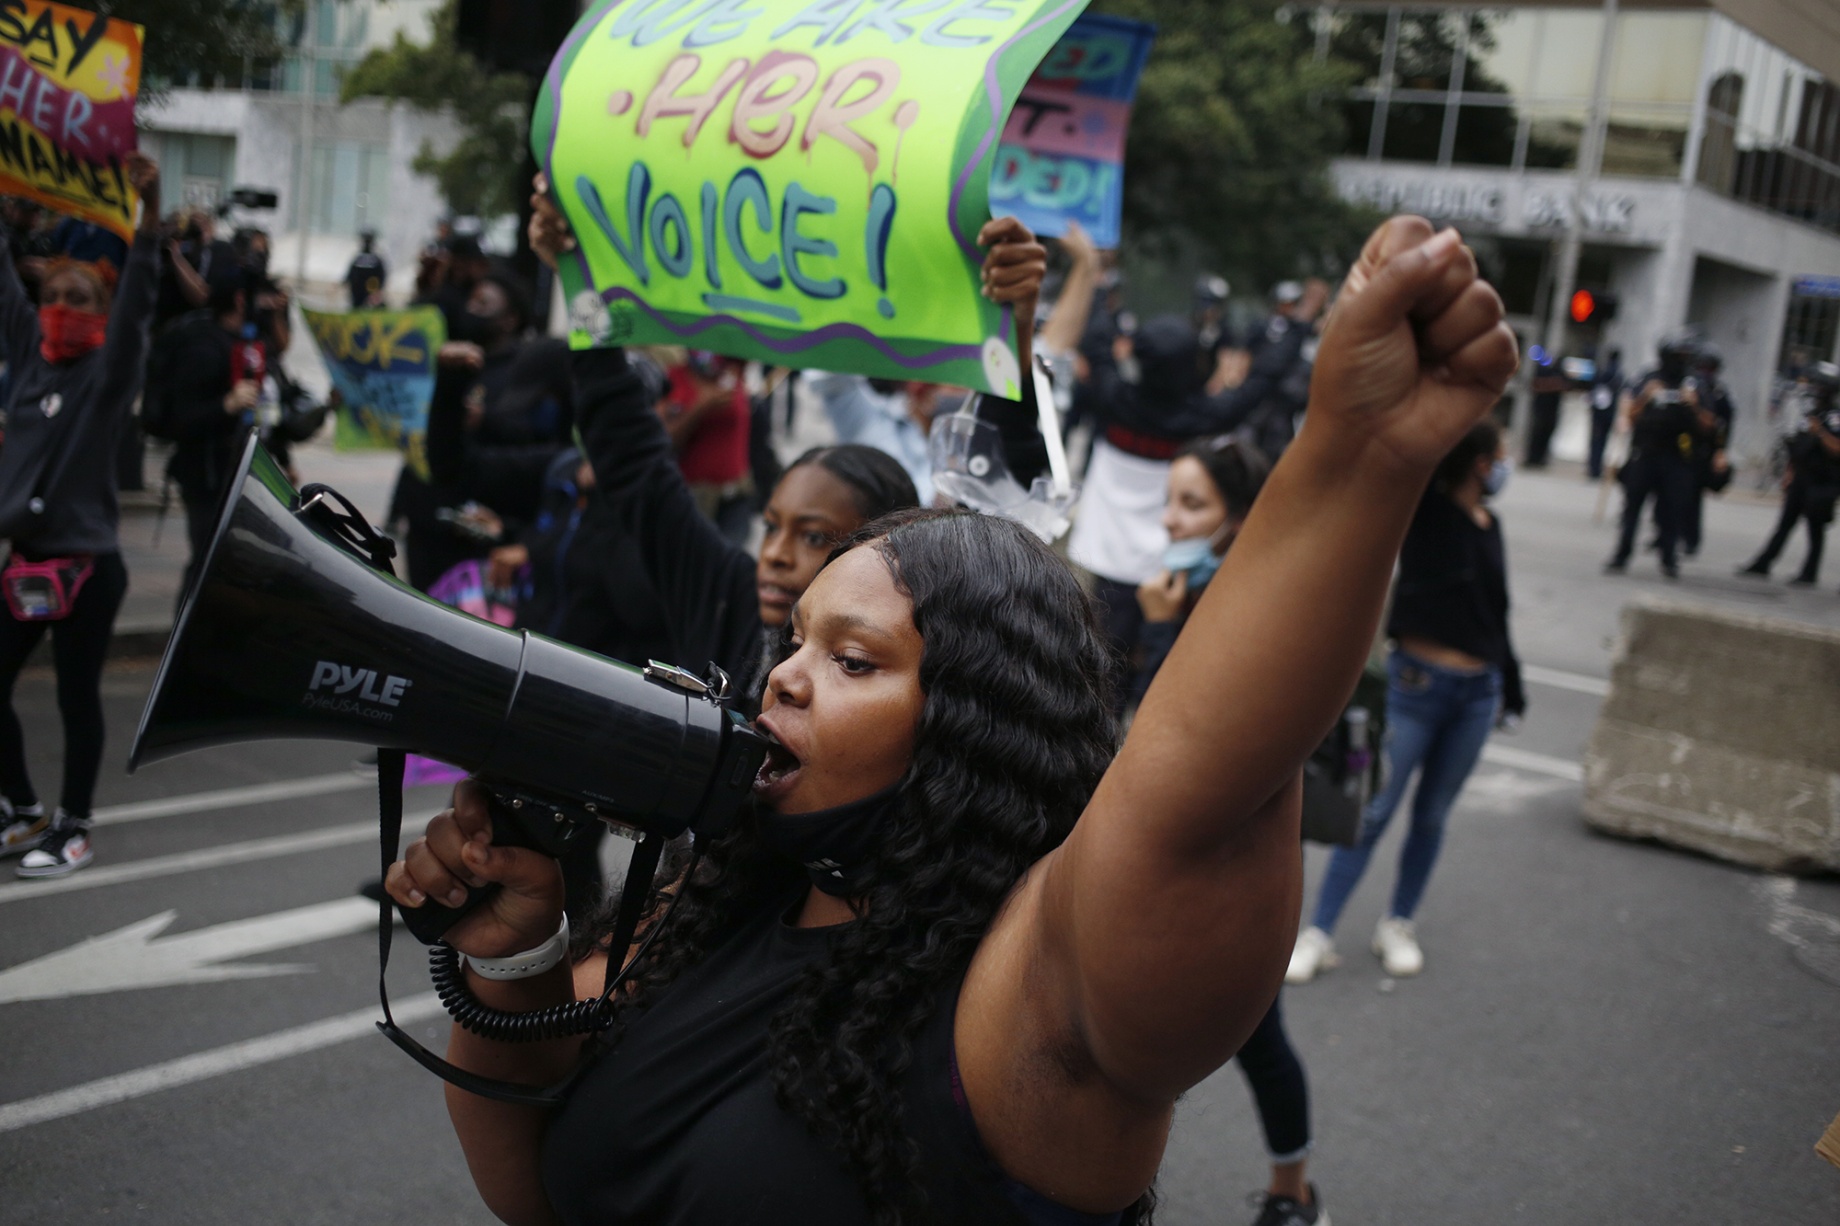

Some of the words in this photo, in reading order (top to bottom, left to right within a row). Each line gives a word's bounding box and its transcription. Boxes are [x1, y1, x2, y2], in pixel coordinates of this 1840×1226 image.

[0, 1, 107, 79] SAY
[609, 0, 766, 48] WE
[769, 0, 1016, 48] ARE
[0, 56, 94, 148] HER
[302, 692, 394, 723] PyleUSA.com
[308, 660, 407, 707] PYLE
